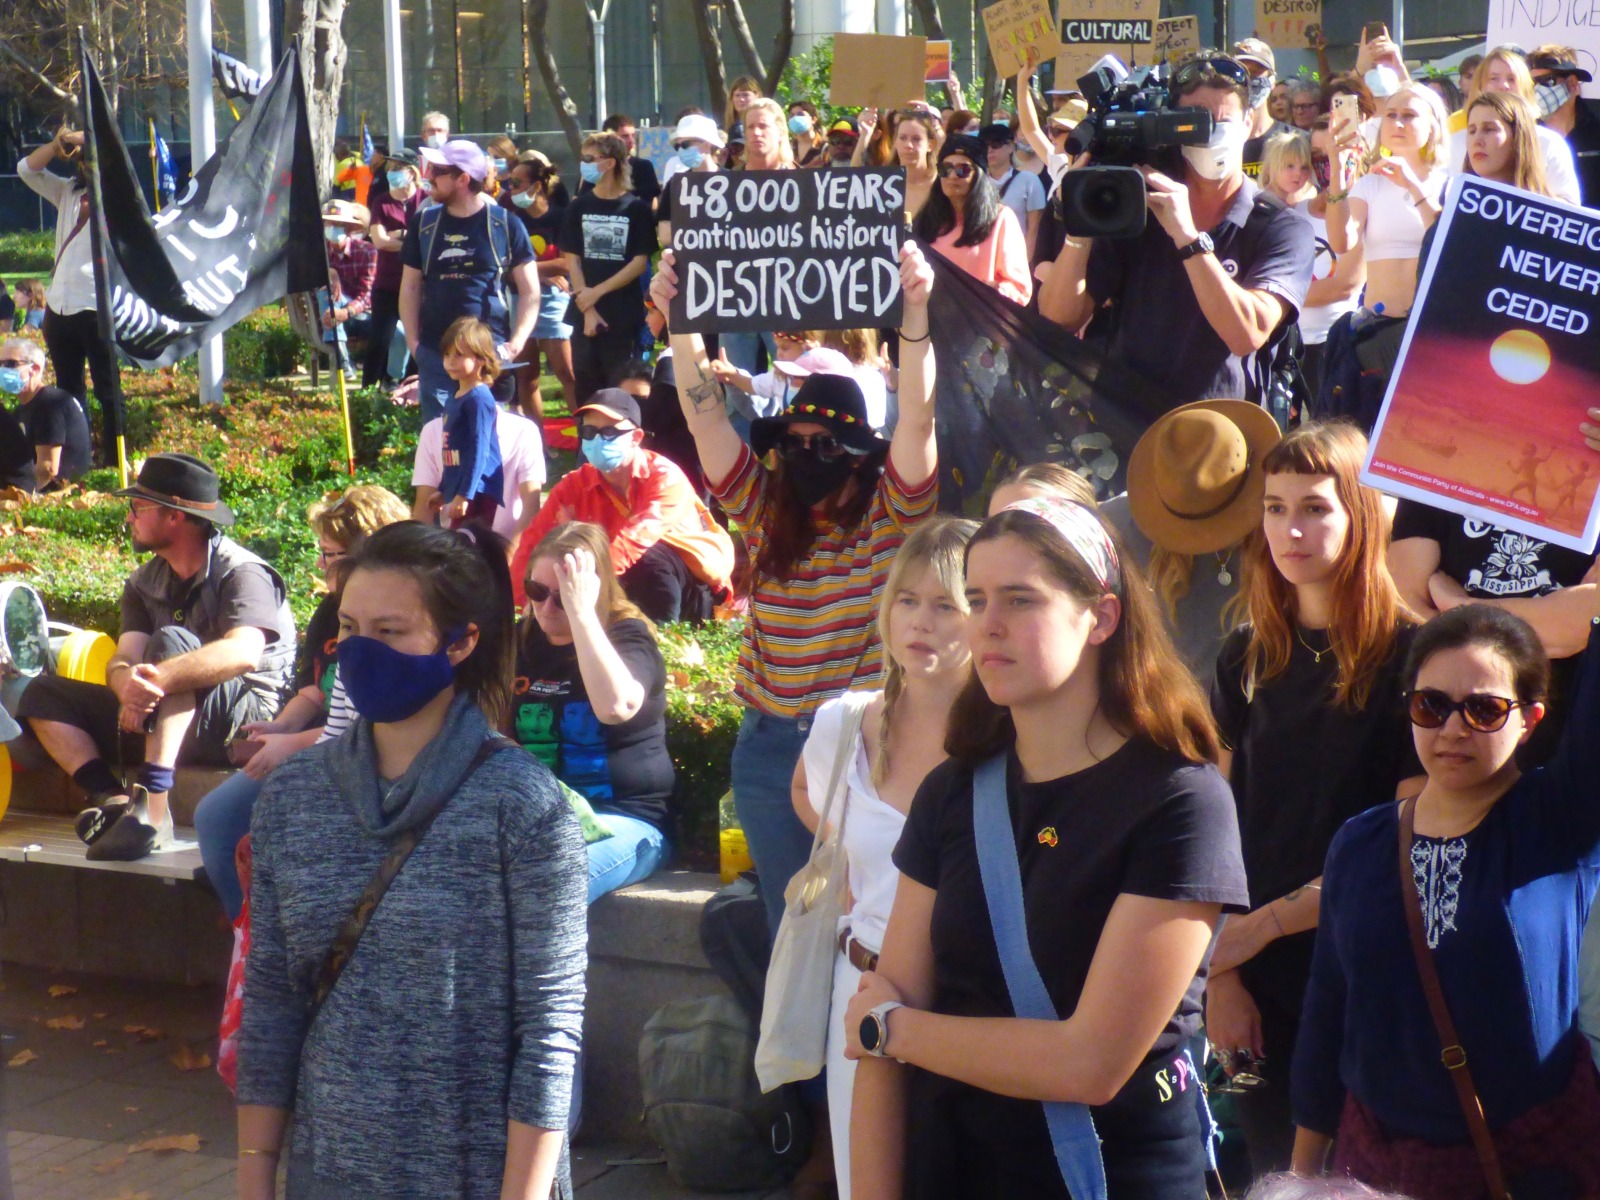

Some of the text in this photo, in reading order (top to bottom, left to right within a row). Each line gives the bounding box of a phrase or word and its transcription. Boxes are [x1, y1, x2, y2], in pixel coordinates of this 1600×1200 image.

[1066, 21, 1151, 41] CULTURAL
[1157, 18, 1192, 33] OTECT
[679, 171, 904, 222] 48,000 YEARS
[673, 213, 901, 263] continuous history
[686, 255, 901, 321] DESTROYED
[1499, 245, 1600, 296] NEVER
[1486, 287, 1589, 335] CEDED
[1373, 460, 1386, 469] Join
[1386, 463, 1397, 473] the
[1398, 467, 1432, 483] Communist
[1432, 477, 1450, 490] Party
[1458, 486, 1485, 500] Australia
[1489, 496, 1539, 516] www.CPA.org.au
